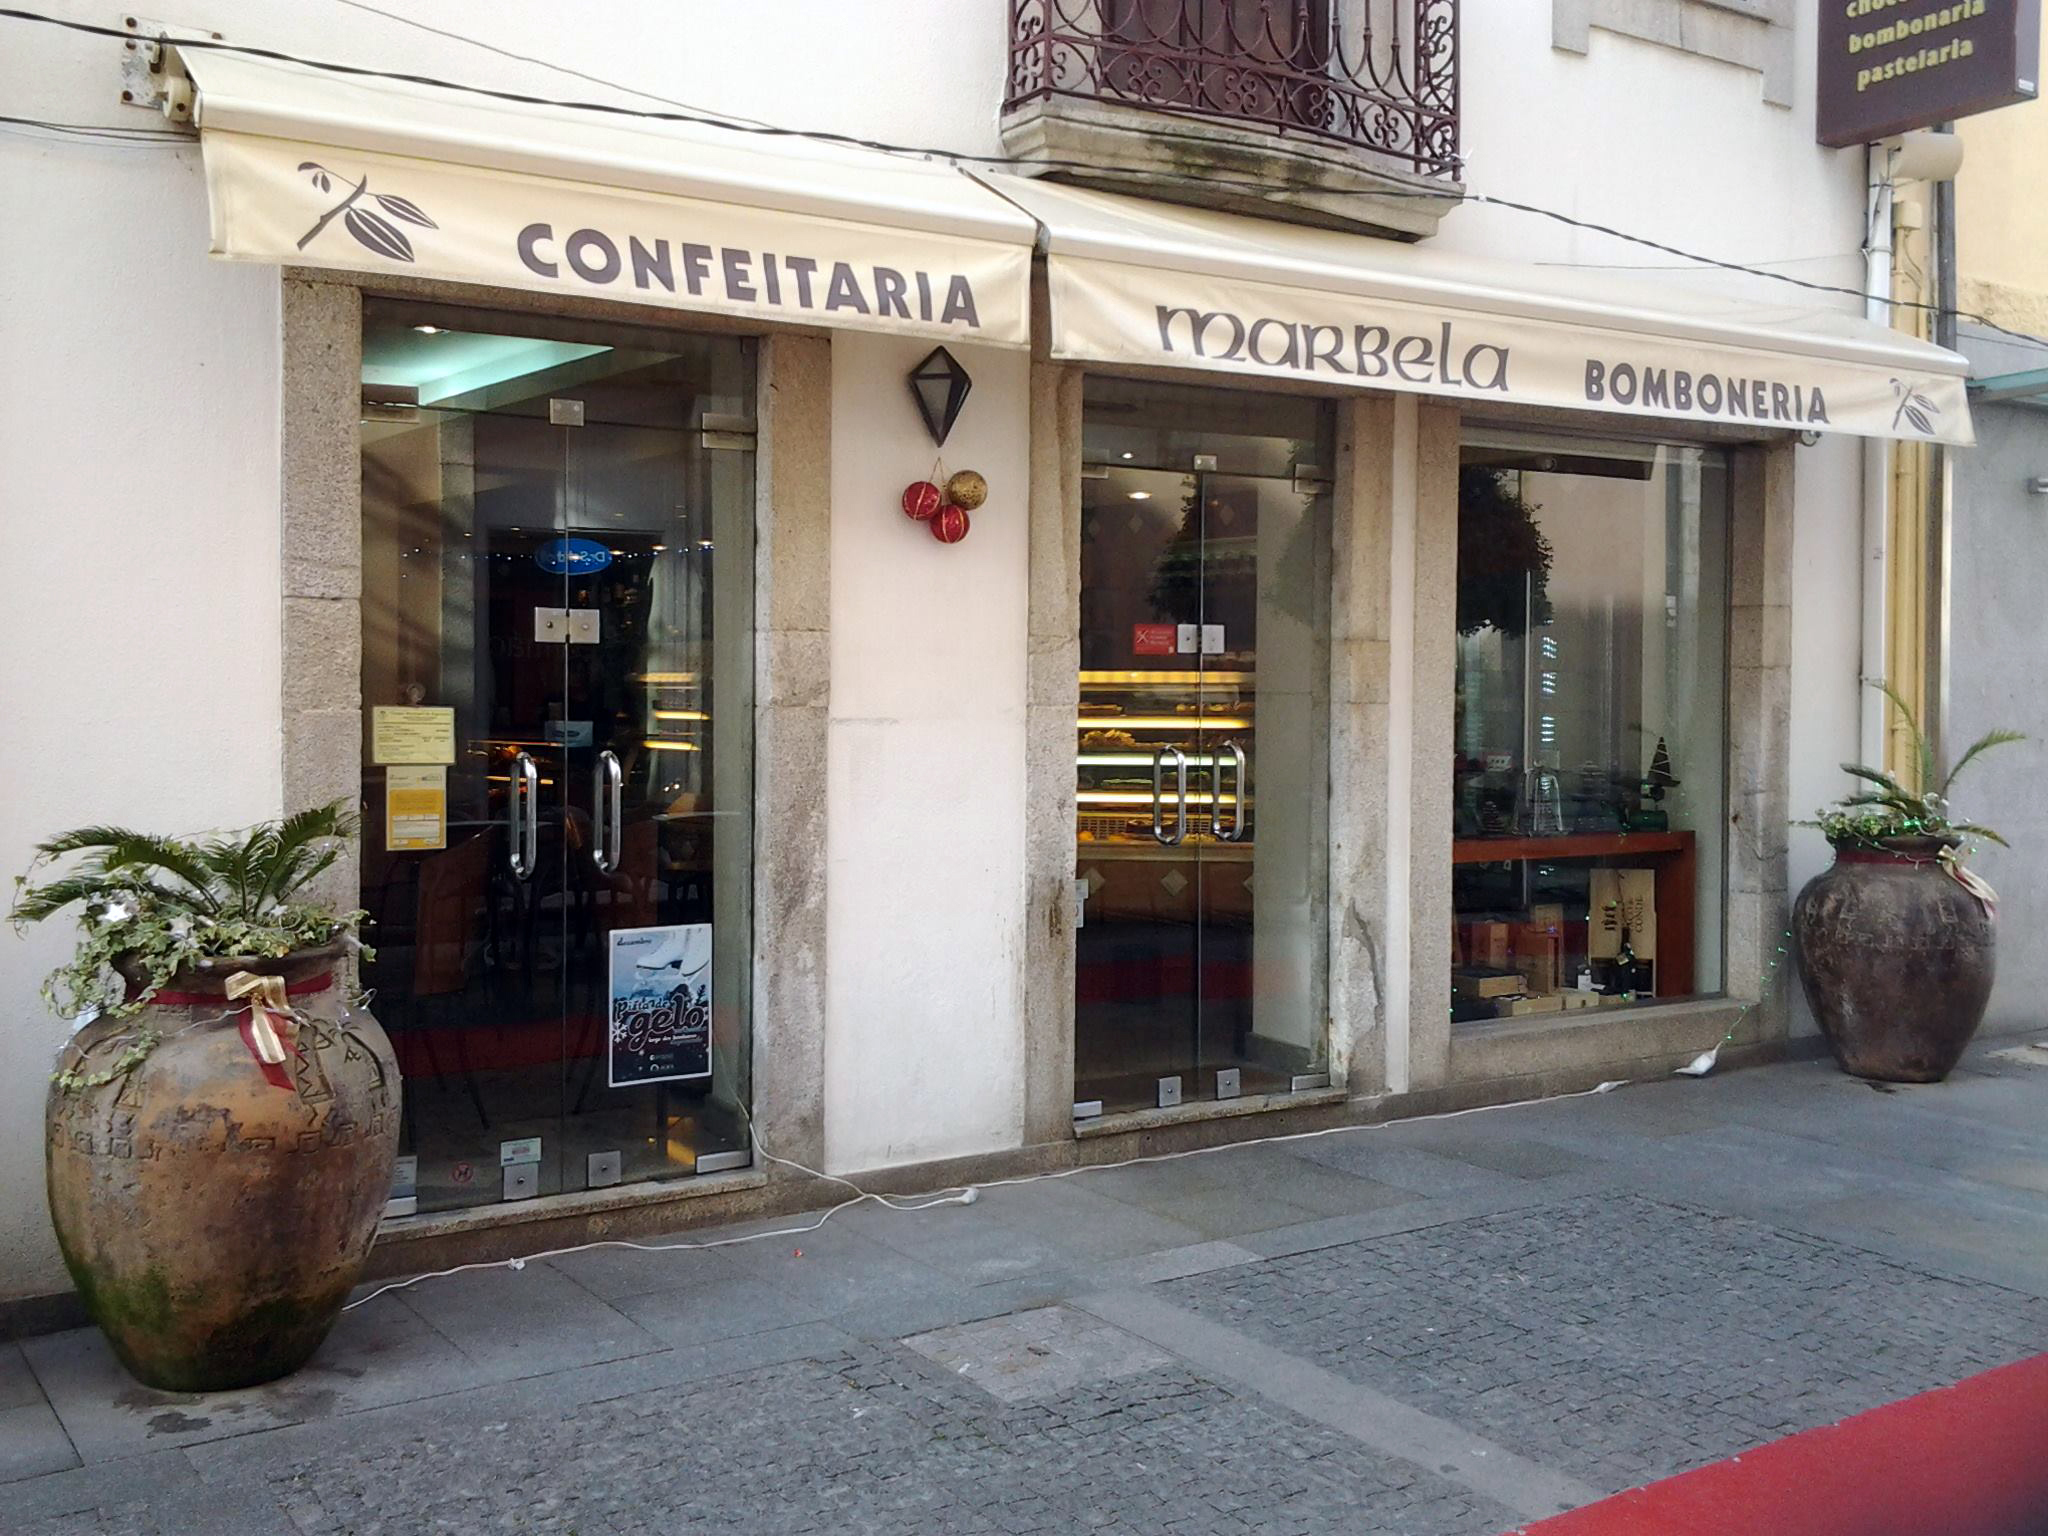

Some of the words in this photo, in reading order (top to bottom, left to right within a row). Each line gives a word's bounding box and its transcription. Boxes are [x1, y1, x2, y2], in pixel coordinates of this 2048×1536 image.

[1848, 0, 1985, 53] bombonaria
[1857, 38, 1974, 92] pastelaria
[517, 222, 980, 328] CONFEITARIA
[1585, 359, 1830, 424] BOMBONERIA
[628, 993, 705, 1052] gelo
